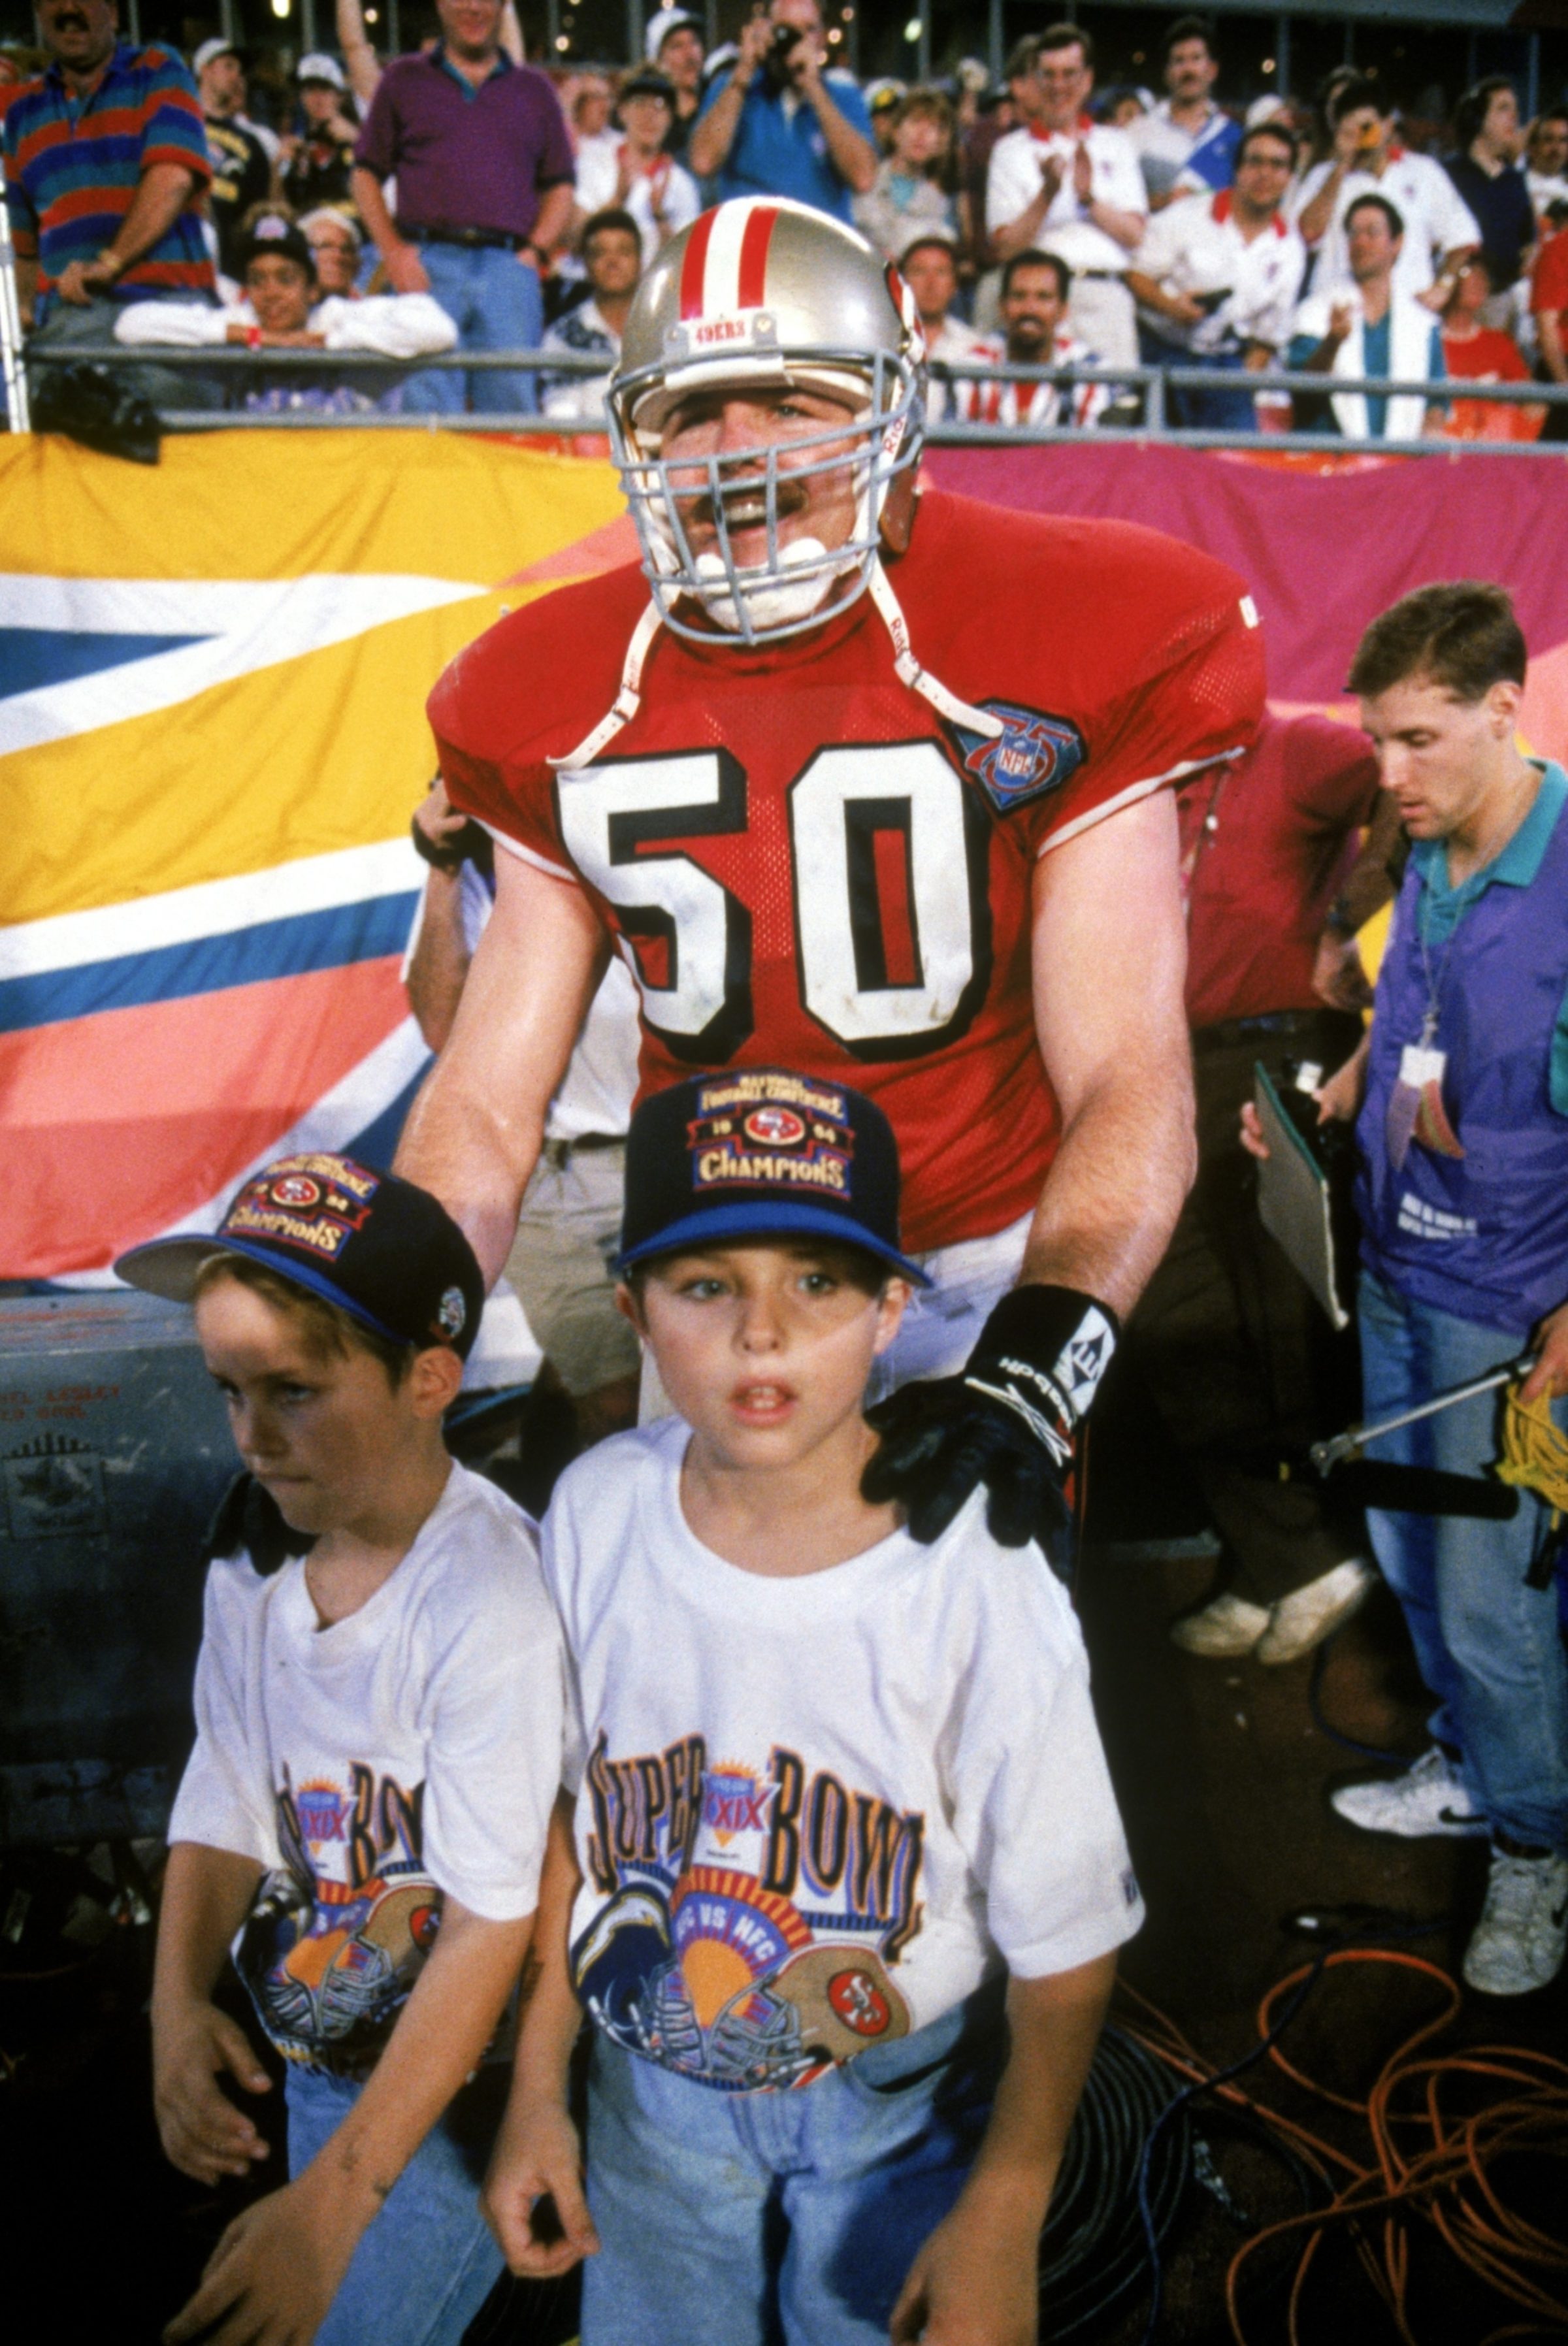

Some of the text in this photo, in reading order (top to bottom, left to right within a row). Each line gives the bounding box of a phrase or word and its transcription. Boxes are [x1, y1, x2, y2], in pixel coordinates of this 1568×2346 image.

[696, 319, 745, 344] 49ERS
[1002, 748, 1034, 775] NFL
[555, 740, 983, 1055] 50
[698, 1149, 845, 1189] CHAMPIONS
[586, 1728, 926, 1966] SUPER BOWL
[700, 1903, 727, 1929] VS
[733, 1914, 776, 1960] NFC
